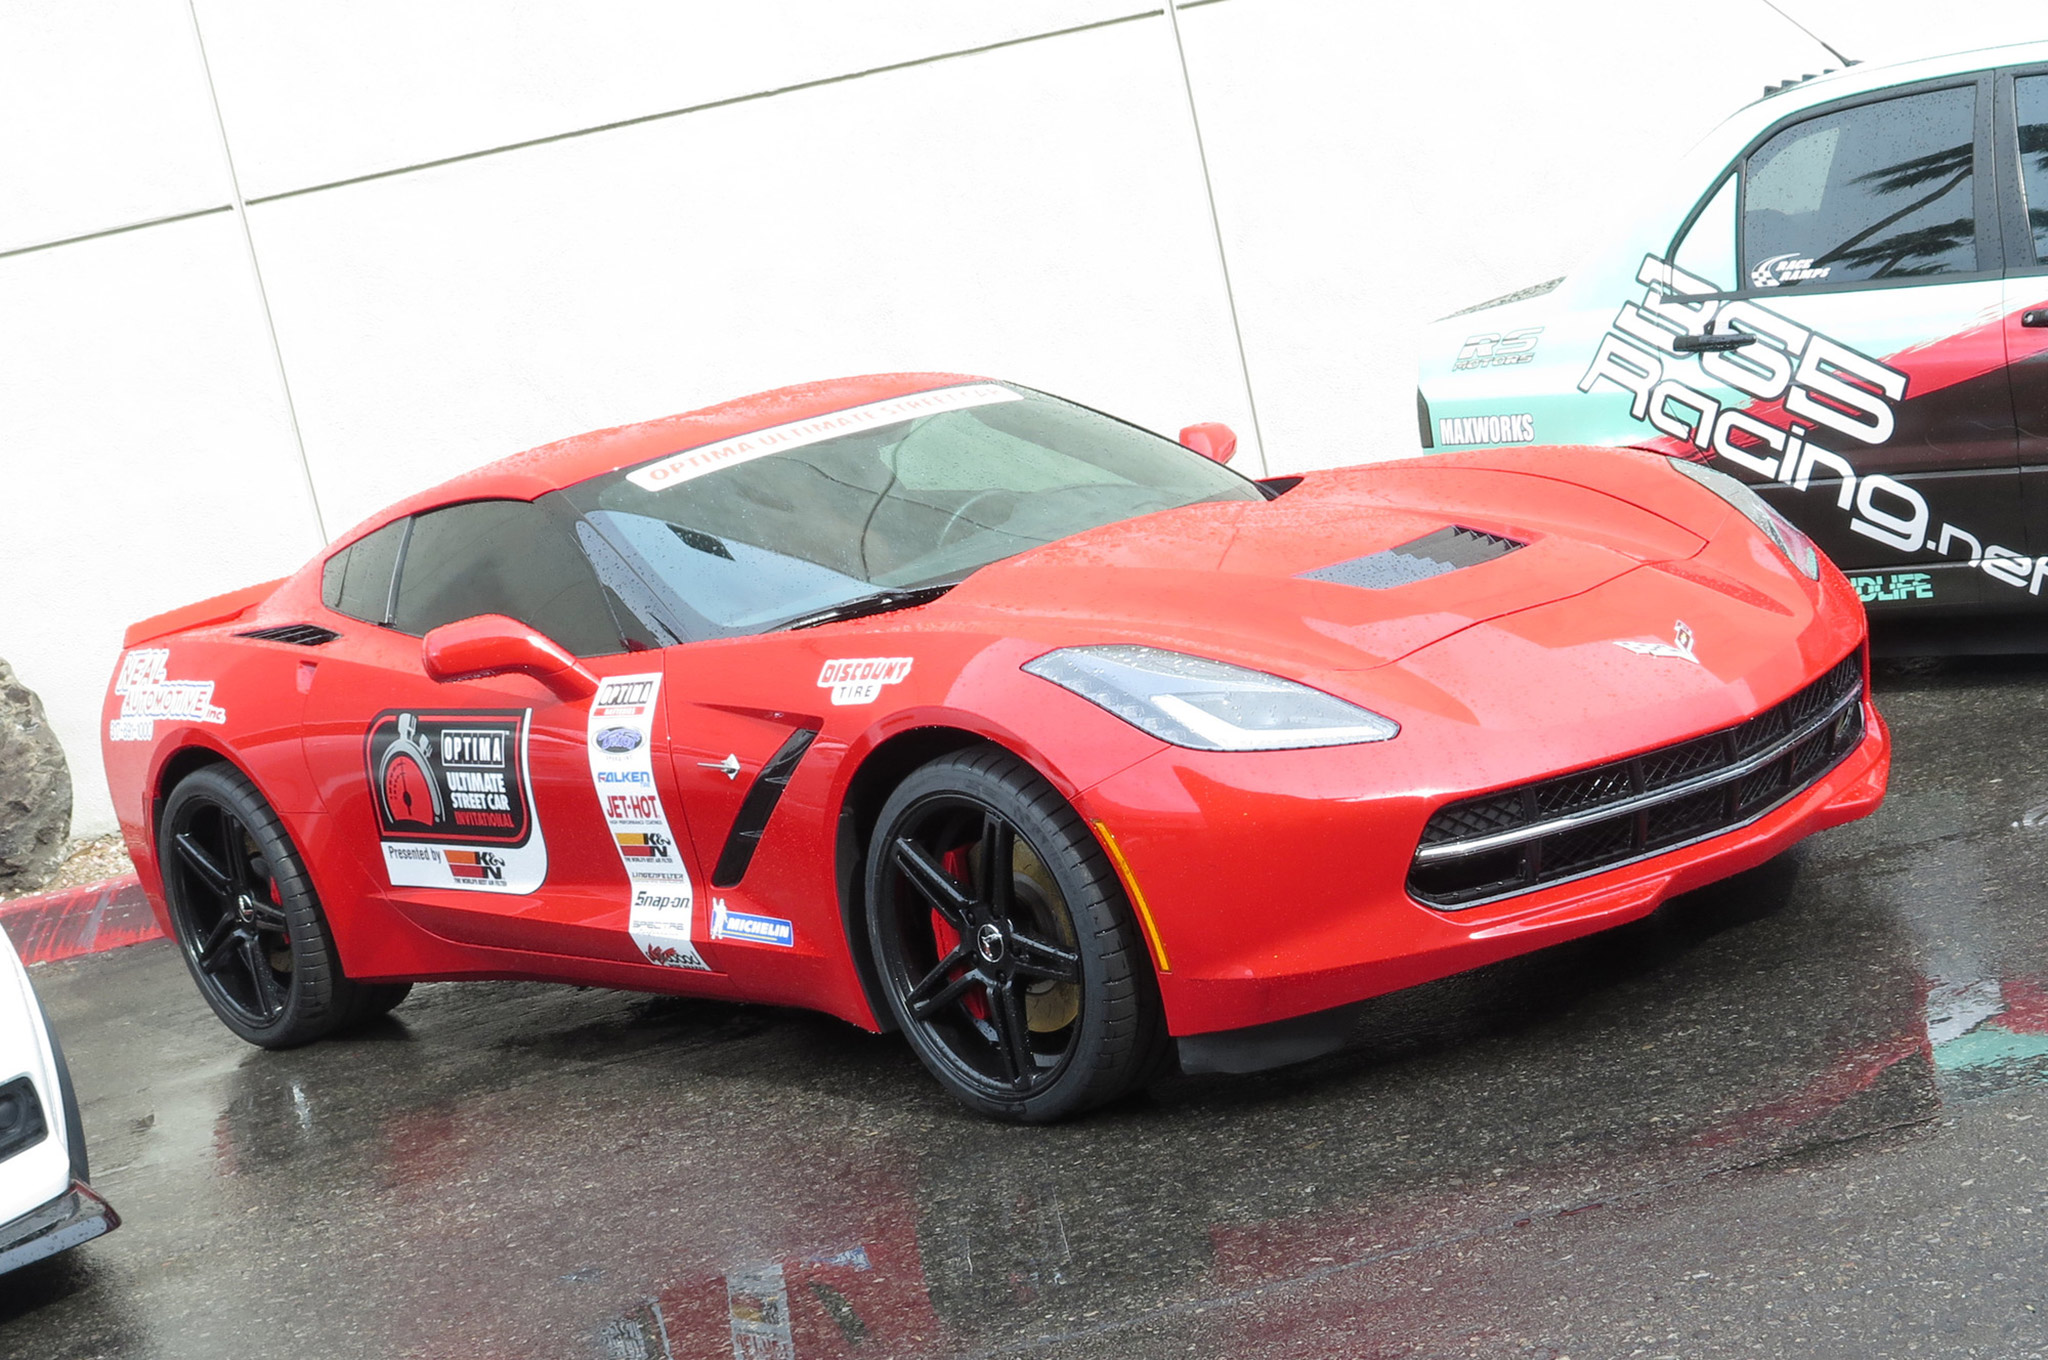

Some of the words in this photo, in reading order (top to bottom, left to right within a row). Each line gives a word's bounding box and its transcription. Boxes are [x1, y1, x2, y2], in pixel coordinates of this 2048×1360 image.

[1775, 258, 1815, 272] RACE
[1779, 267, 1832, 281] RAMPS
[1456, 326, 1545, 360] RS
[1451, 352, 1537, 372] MOTORS
[1439, 413, 1535, 446] MAXWORKS
[649, 440, 756, 481] OPTIMA
[758, 409, 877, 446] ULTIMATE
[116, 650, 168, 692] NEAL
[821, 661, 909, 683] DISCOUNT
[122, 684, 213, 718] AUTOMOTIVE
[598, 681, 654, 706] OPTIMA
[839, 685, 874, 699] TIRE
[444, 736, 502, 762] OPTIMA
[446, 771, 507, 793] ULTIMATE
[598, 771, 650, 782] FALKEN
[450, 792, 488, 810] STREET
[487, 794, 511, 811] CAR
[454, 811, 516, 828] INVITATIONAL
[388, 846, 430, 861] Presented
[429, 848, 442, 863] by
[635, 891, 690, 911] Snap-on
[633, 921, 684, 931] SPECTRE
[726, 917, 790, 938] MICHELIN
